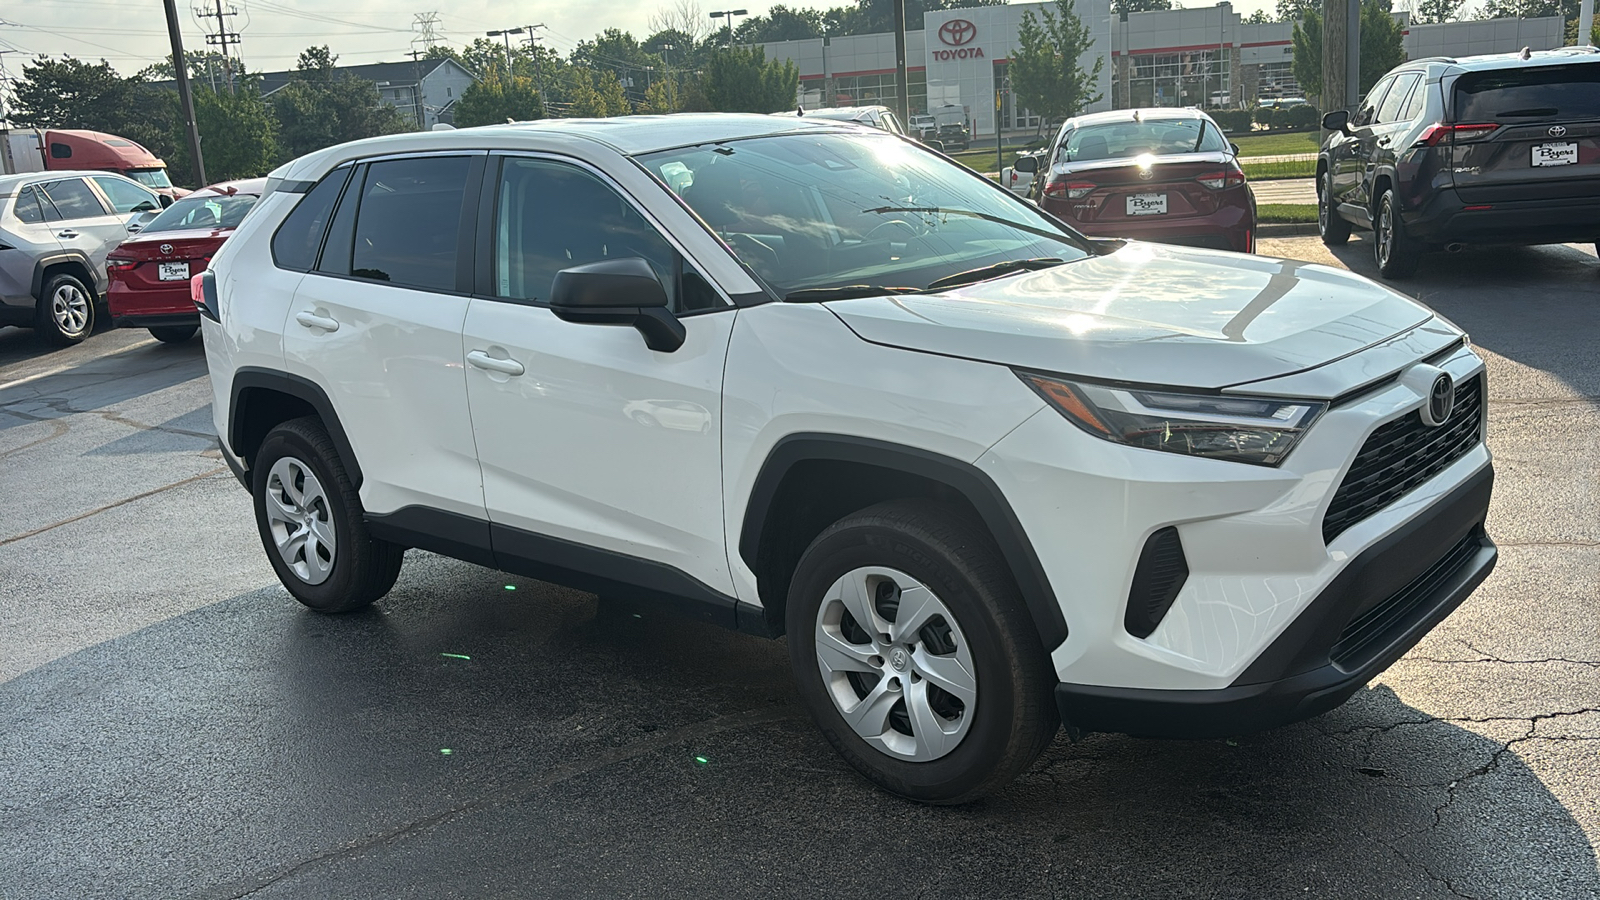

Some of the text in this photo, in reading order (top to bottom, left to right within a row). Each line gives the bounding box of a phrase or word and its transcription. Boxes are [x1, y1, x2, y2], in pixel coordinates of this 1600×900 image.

[932, 47, 984, 61] TOYOTA
[1536, 148, 1573, 158] Byers
[1130, 198, 1163, 209] Byers
[162, 265, 186, 275] Byers
